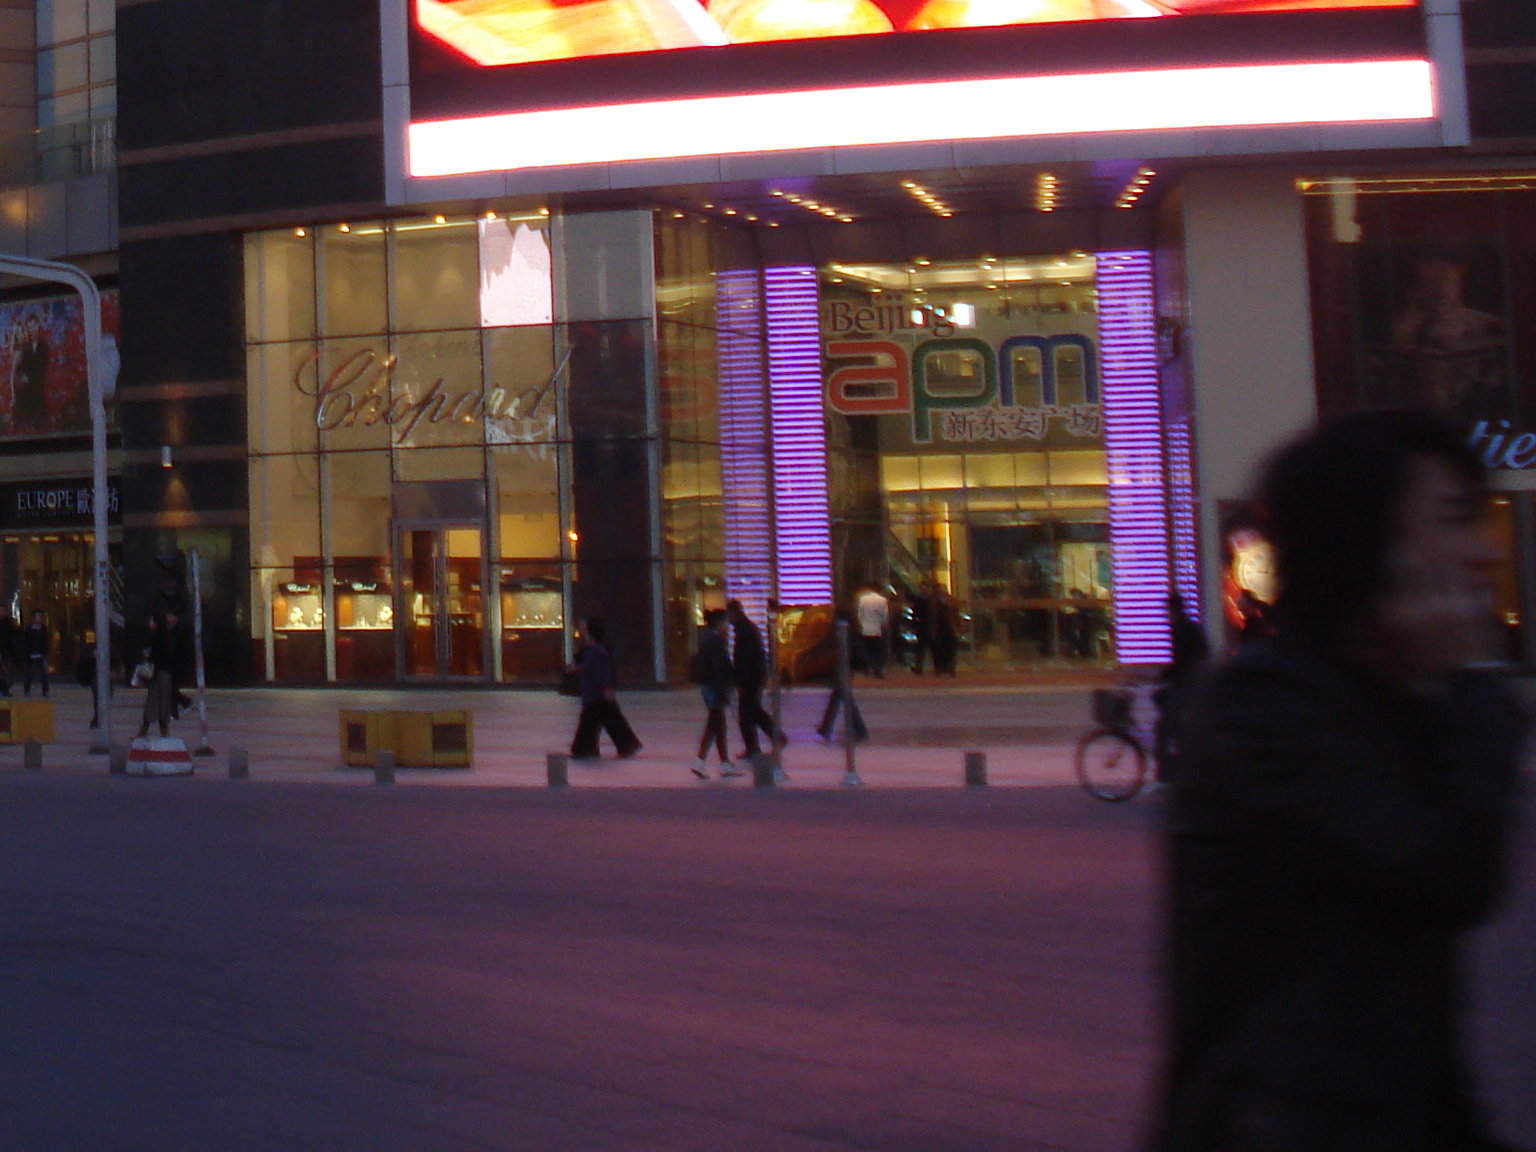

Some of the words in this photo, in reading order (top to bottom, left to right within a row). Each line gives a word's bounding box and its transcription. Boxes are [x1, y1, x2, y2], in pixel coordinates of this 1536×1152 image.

[828, 298, 956, 337] Beijing
[294, 343, 574, 445] Chopard
[826, 333, 1100, 444] apm
[942, 408, 1101, 441] 新东安广场
[17, 489, 75, 510] EUROPE
